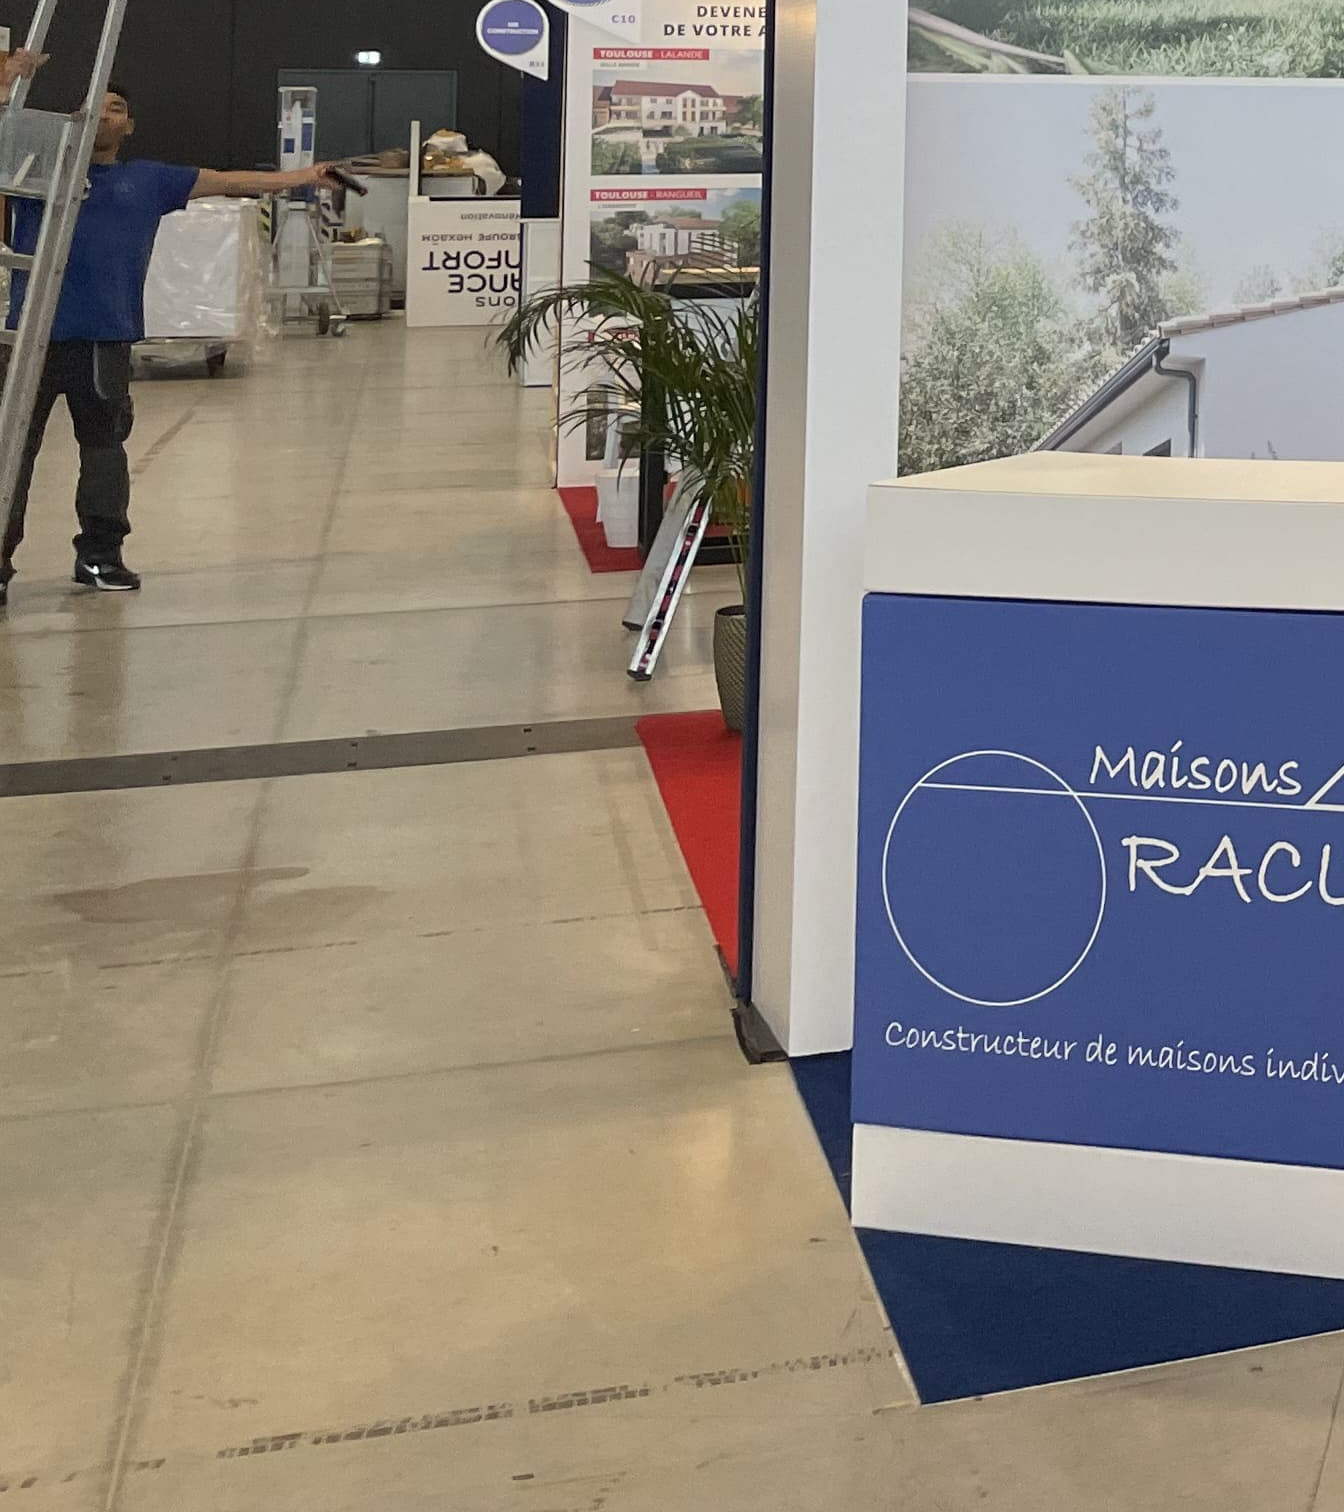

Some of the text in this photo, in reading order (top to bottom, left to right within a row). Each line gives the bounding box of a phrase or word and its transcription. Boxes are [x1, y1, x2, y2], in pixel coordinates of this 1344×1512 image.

[611, 14, 636, 24] C10
[664, 24, 686, 36] DE
[692, 25, 751, 37] VOTRE
[600, 50, 653, 59] TOULOUSE
[595, 191, 648, 200] TOULOUSE
[478, 233, 520, 241] ROUPE
[1089, 741, 1303, 794] Maisons
[885, 1021, 1077, 1063] Constructeur
[1086, 1033, 1118, 1066] de
[1127, 1039, 1256, 1077] maisons
